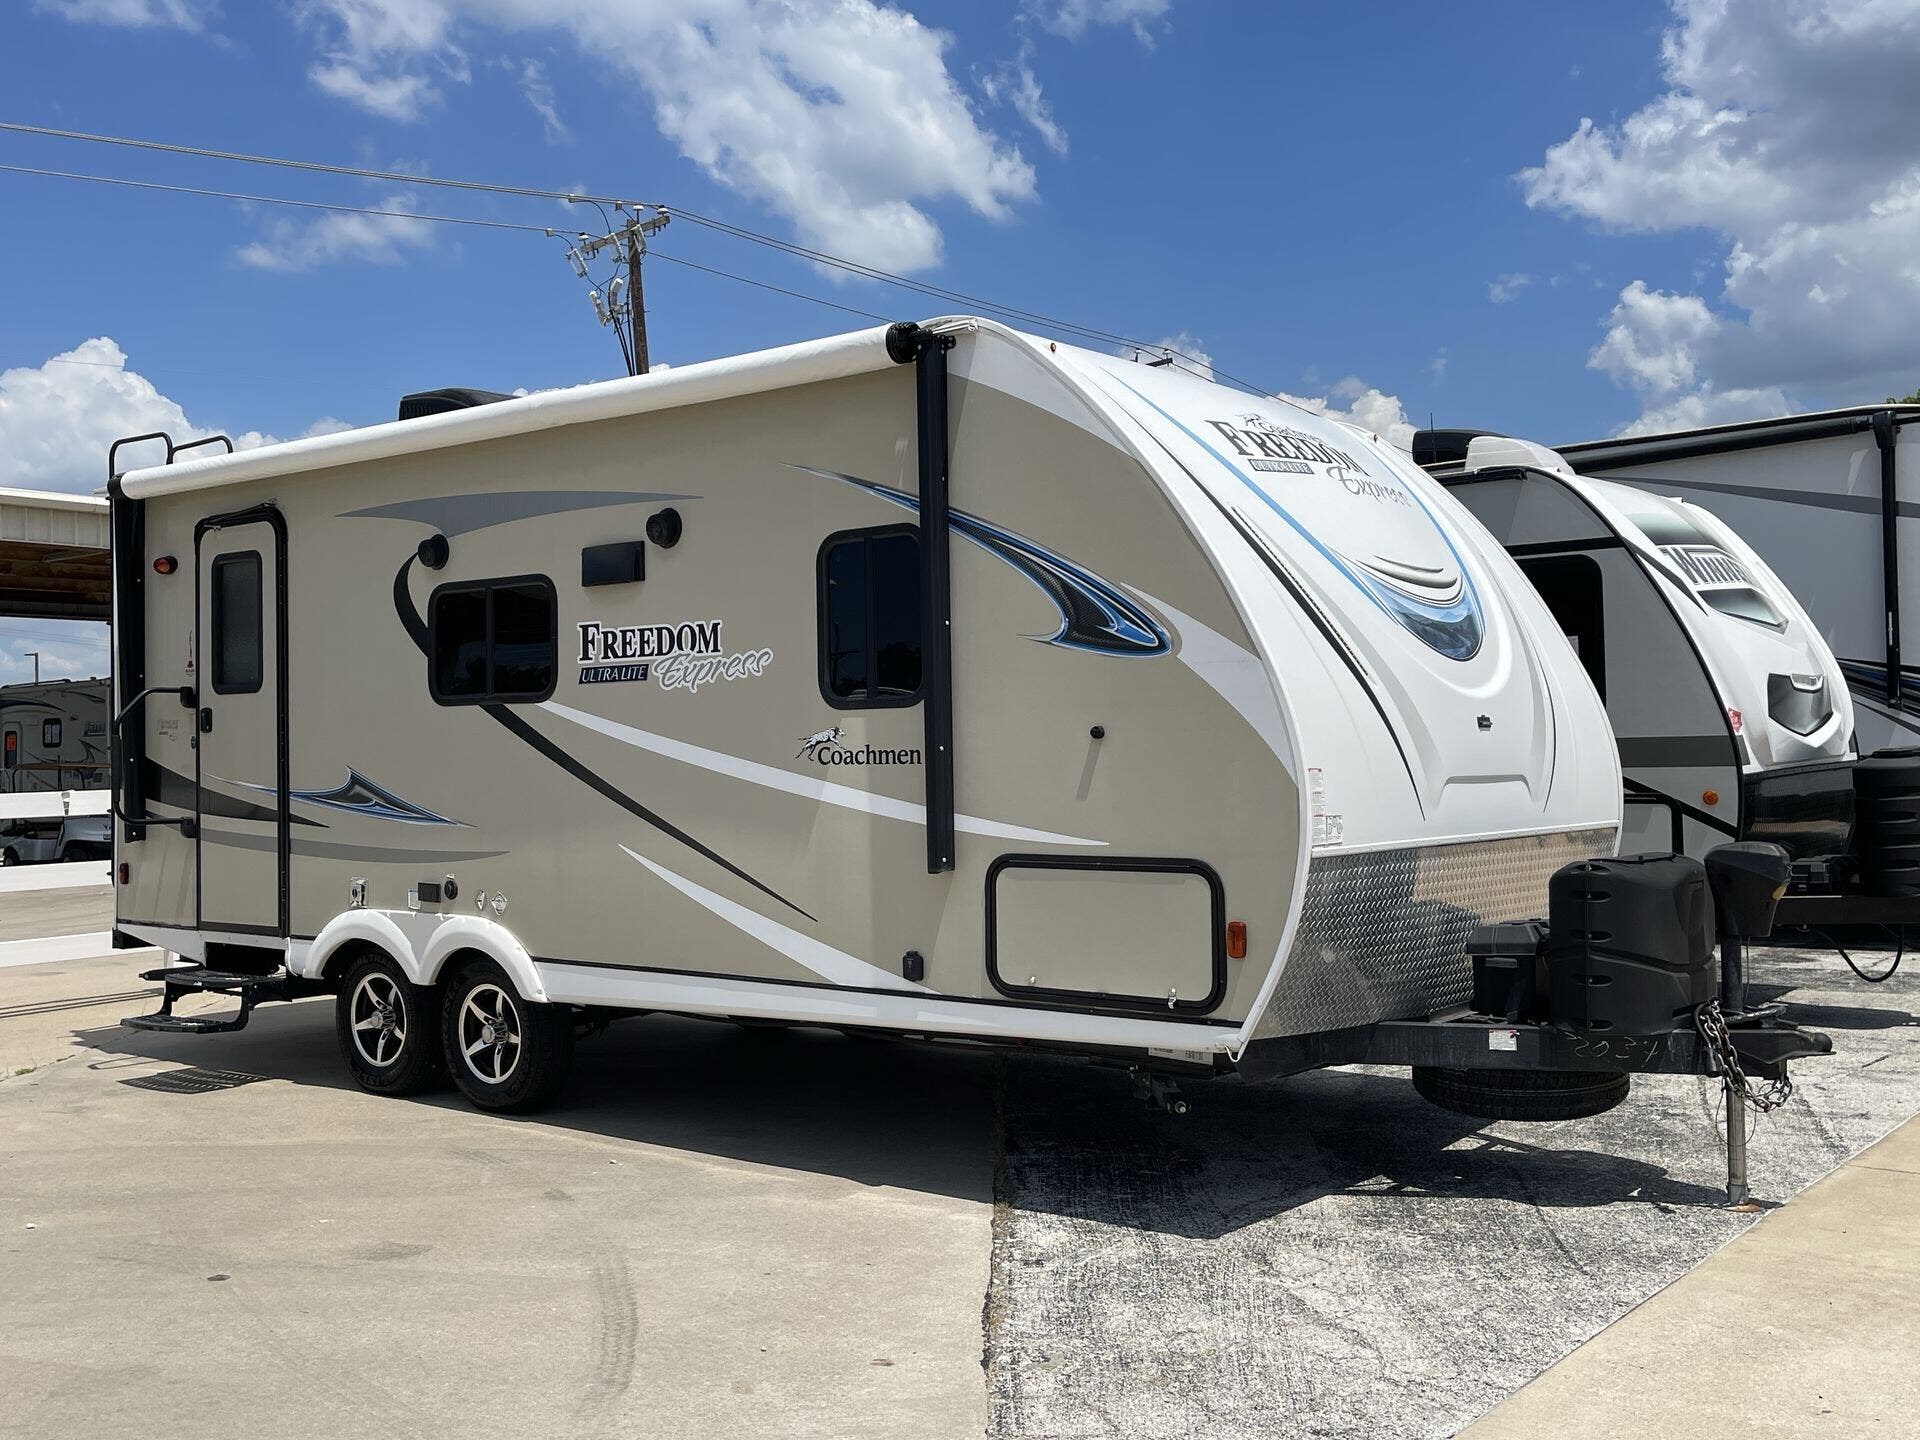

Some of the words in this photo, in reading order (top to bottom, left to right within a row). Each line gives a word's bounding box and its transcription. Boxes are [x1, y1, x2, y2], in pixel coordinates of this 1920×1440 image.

[1205, 420, 1371, 477] FREEDOM
[1326, 466, 1411, 507] Express
[578, 621, 721, 662] FREEDOM
[653, 650, 772, 691] Express
[817, 744, 922, 766] Coachmen
